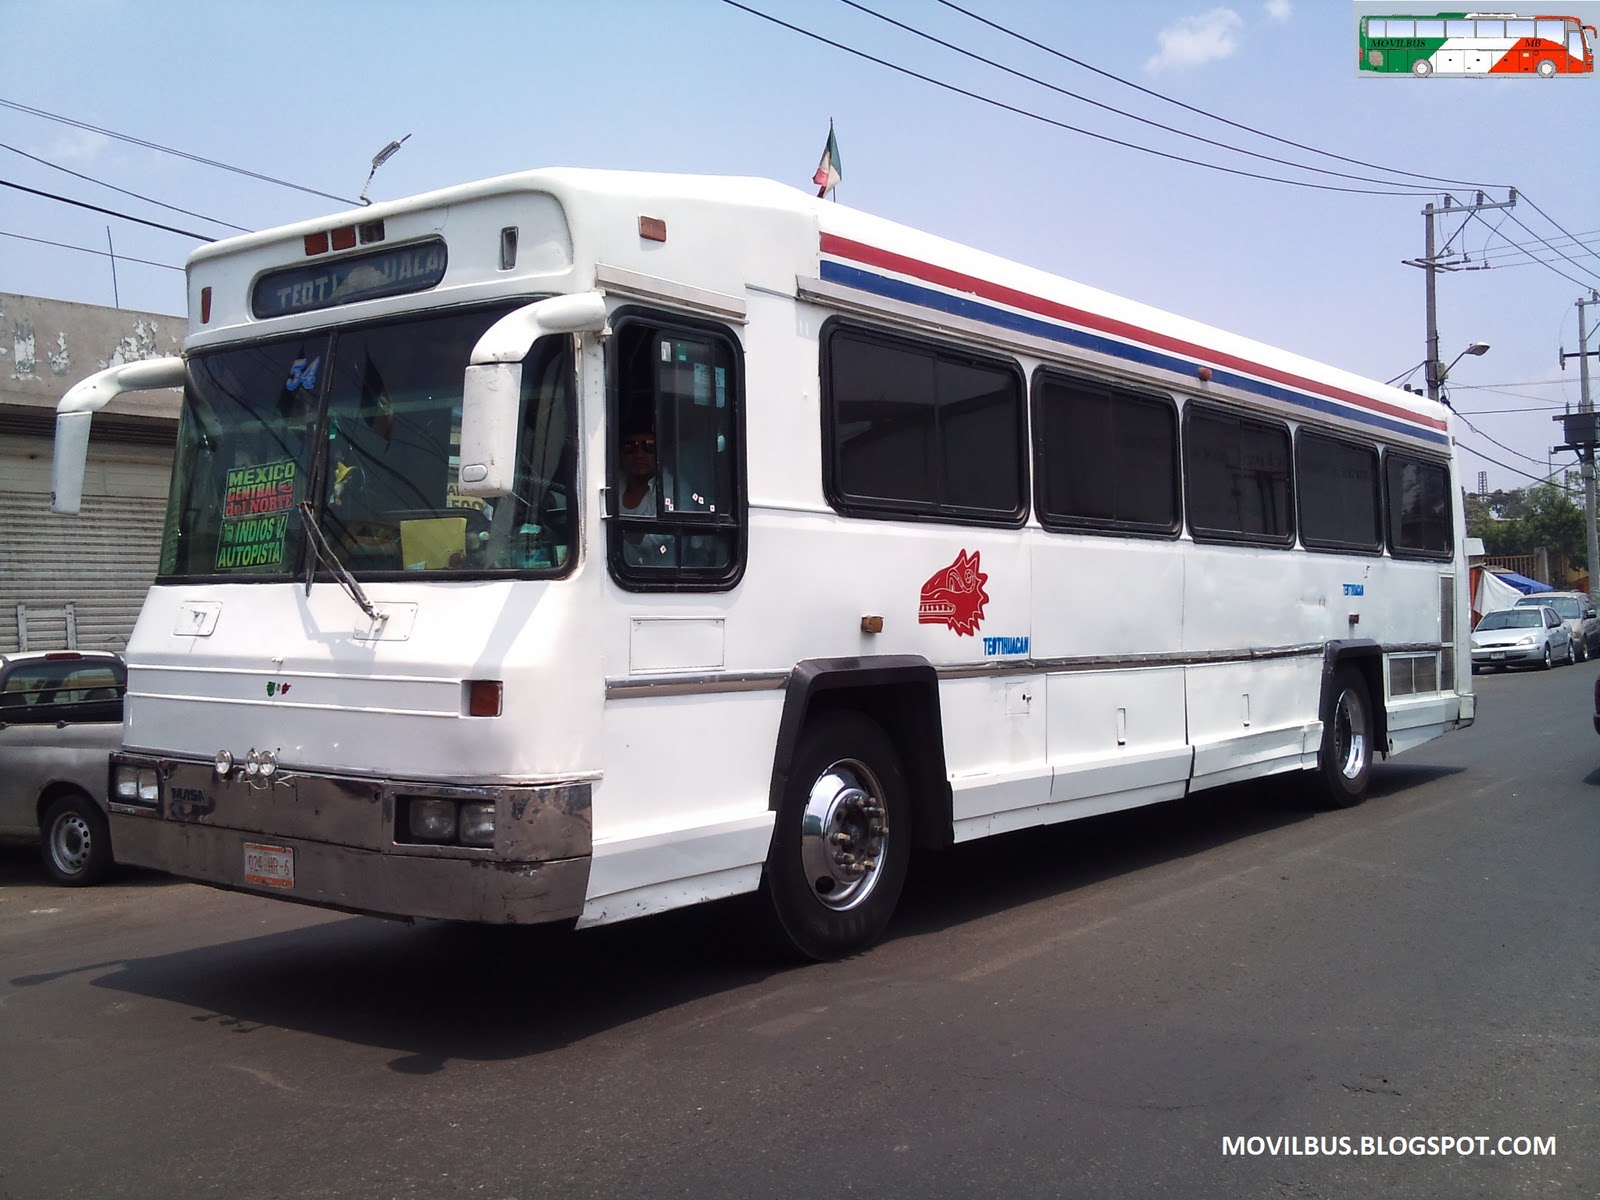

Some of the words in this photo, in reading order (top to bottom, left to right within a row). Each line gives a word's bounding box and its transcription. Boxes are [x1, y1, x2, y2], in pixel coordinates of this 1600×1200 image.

[278, 251, 446, 308] TEOTIUACA
[286, 356, 320, 390] 54
[229, 462, 295, 486] MEXICO
[227, 481, 277, 502] CENTRAL
[226, 502, 246, 517] del
[250, 494, 293, 512] NORTE
[235, 517, 275, 543] INDIOS
[218, 542, 280, 567] AUTOPISTA
[171, 787, 208, 801] MASA
